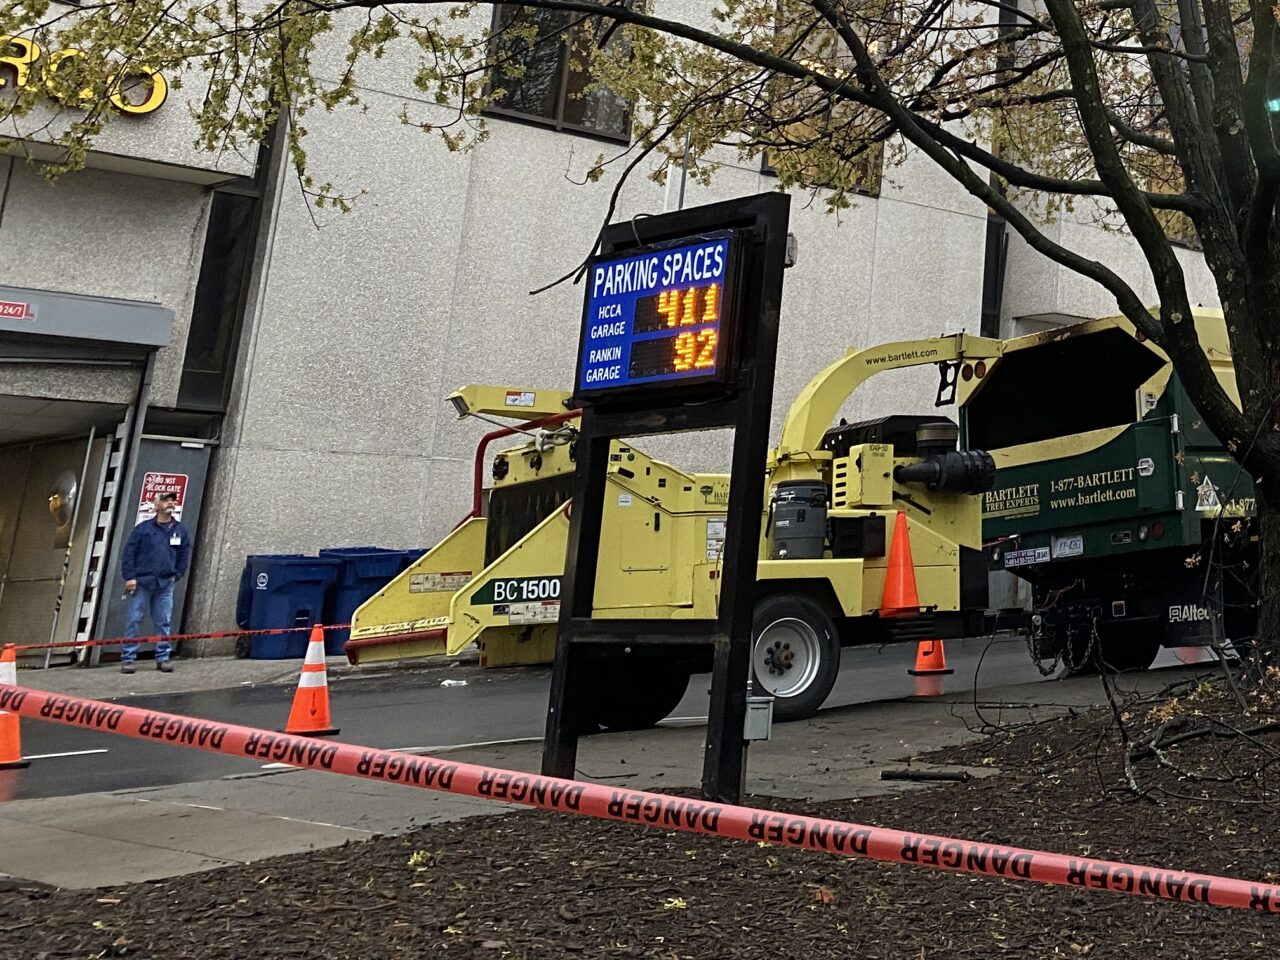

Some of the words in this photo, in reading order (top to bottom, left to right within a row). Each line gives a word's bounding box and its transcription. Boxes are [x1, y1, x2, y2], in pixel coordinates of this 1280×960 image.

[594, 257, 658, 298] PARKING
[662, 245, 723, 286] SPACES
[598, 304, 621, 319] HCCA
[658, 283, 719, 328] 411
[591, 322, 625, 339] GARAGE
[589, 346, 621, 363] RANKIN
[673, 328, 717, 372] 92
[865, 349, 938, 365] www.bartlett.com
[586, 365, 621, 382] GARAGE
[167, 485, 182, 493] GATE
[1050, 468, 1135, 493] 1-877-BARTLETT
[985, 484, 1039, 504] BARTLETT
[1050, 488, 1136, 509] www.bartlett.com
[986, 502, 1005, 512] TREE
[1006, 495, 1039, 509] EXPERTS
[40, 696, 123, 731] DANGER
[139, 714, 226, 749] DANGER
[244, 732, 338, 769] DANGER
[357, 751, 457, 790] DANGER
[477, 770, 585, 810] DANGER
[608, 791, 723, 832] DANGER
[748, 812, 872, 856] DANGER
[901, 835, 1034, 879] DANGER
[1066, 859, 1212, 902] DANGER
